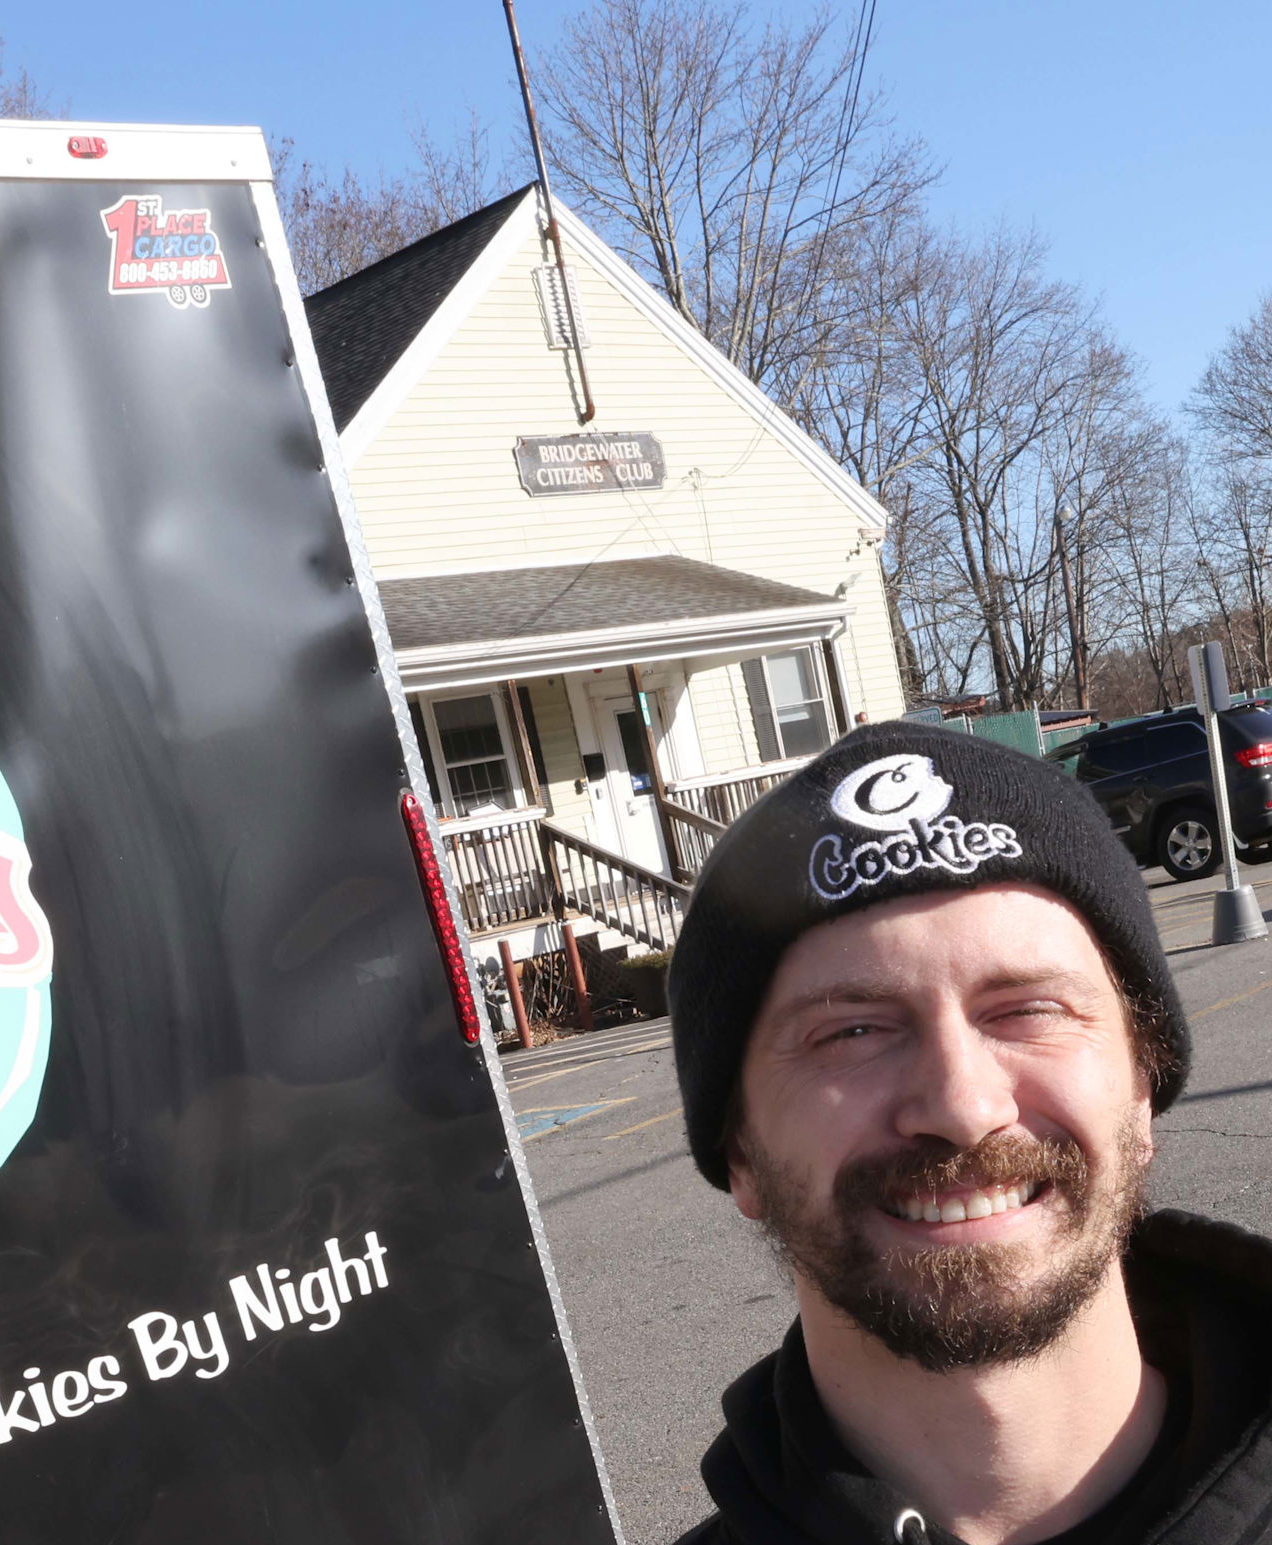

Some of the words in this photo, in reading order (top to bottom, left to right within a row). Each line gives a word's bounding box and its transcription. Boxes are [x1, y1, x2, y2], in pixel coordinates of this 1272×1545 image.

[136, 213, 207, 236] PLACE
[134, 234, 216, 259] CARGO
[538, 441, 643, 463] BRIDGEWATER
[536, 465, 604, 487] CITIZENS
[615, 462, 654, 481] CLUB
[809, 815, 1023, 900] Cookies
[127, 1310, 230, 1381] By
[228, 1231, 389, 1342] Night
